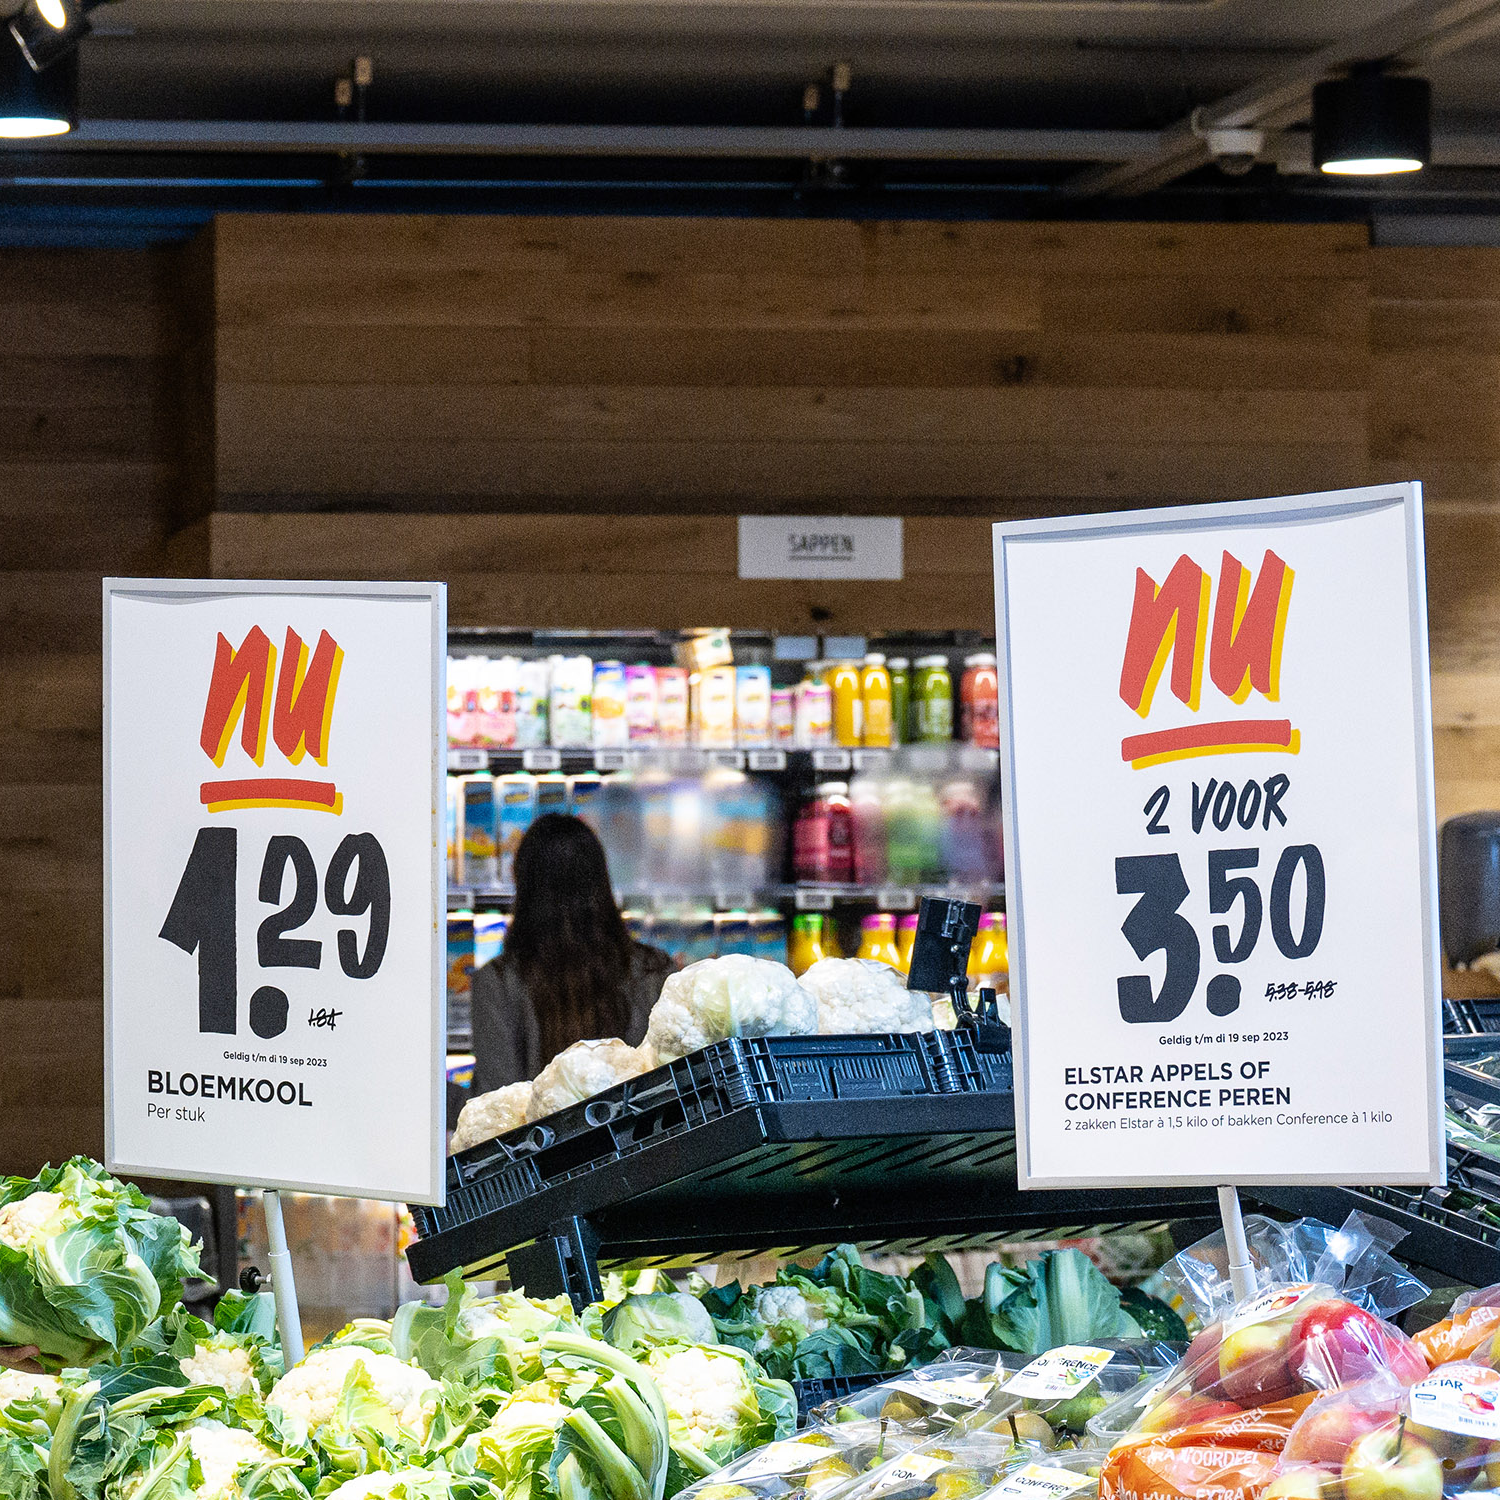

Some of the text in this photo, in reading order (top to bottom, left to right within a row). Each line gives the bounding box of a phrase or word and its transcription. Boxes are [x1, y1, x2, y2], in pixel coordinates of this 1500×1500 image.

[1144, 773, 1291, 835] 2 VOOR
[158, 826, 392, 1040] 1.29
[1114, 843, 1326, 1024] 3.50
[307, 1008, 343, 1031] 1.84
[1159, 1031, 1289, 1046] Geldig t/m di 19 sep 2023
[223, 1051, 327, 1067] Geldig t/m di 19 sep 2023
[1064, 1061, 1270, 1085] ELSTAR APPELS OF
[147, 1069, 313, 1107] BLOEMKOOL
[1064, 1087, 1291, 1111] CONFERENCE PEREN
[147, 1103, 206, 1122] Per stuk
[1064, 1111, 1393, 1131] 2 zakken Elstar à 1,5 kilo of bakken Conference à 1 kilo
